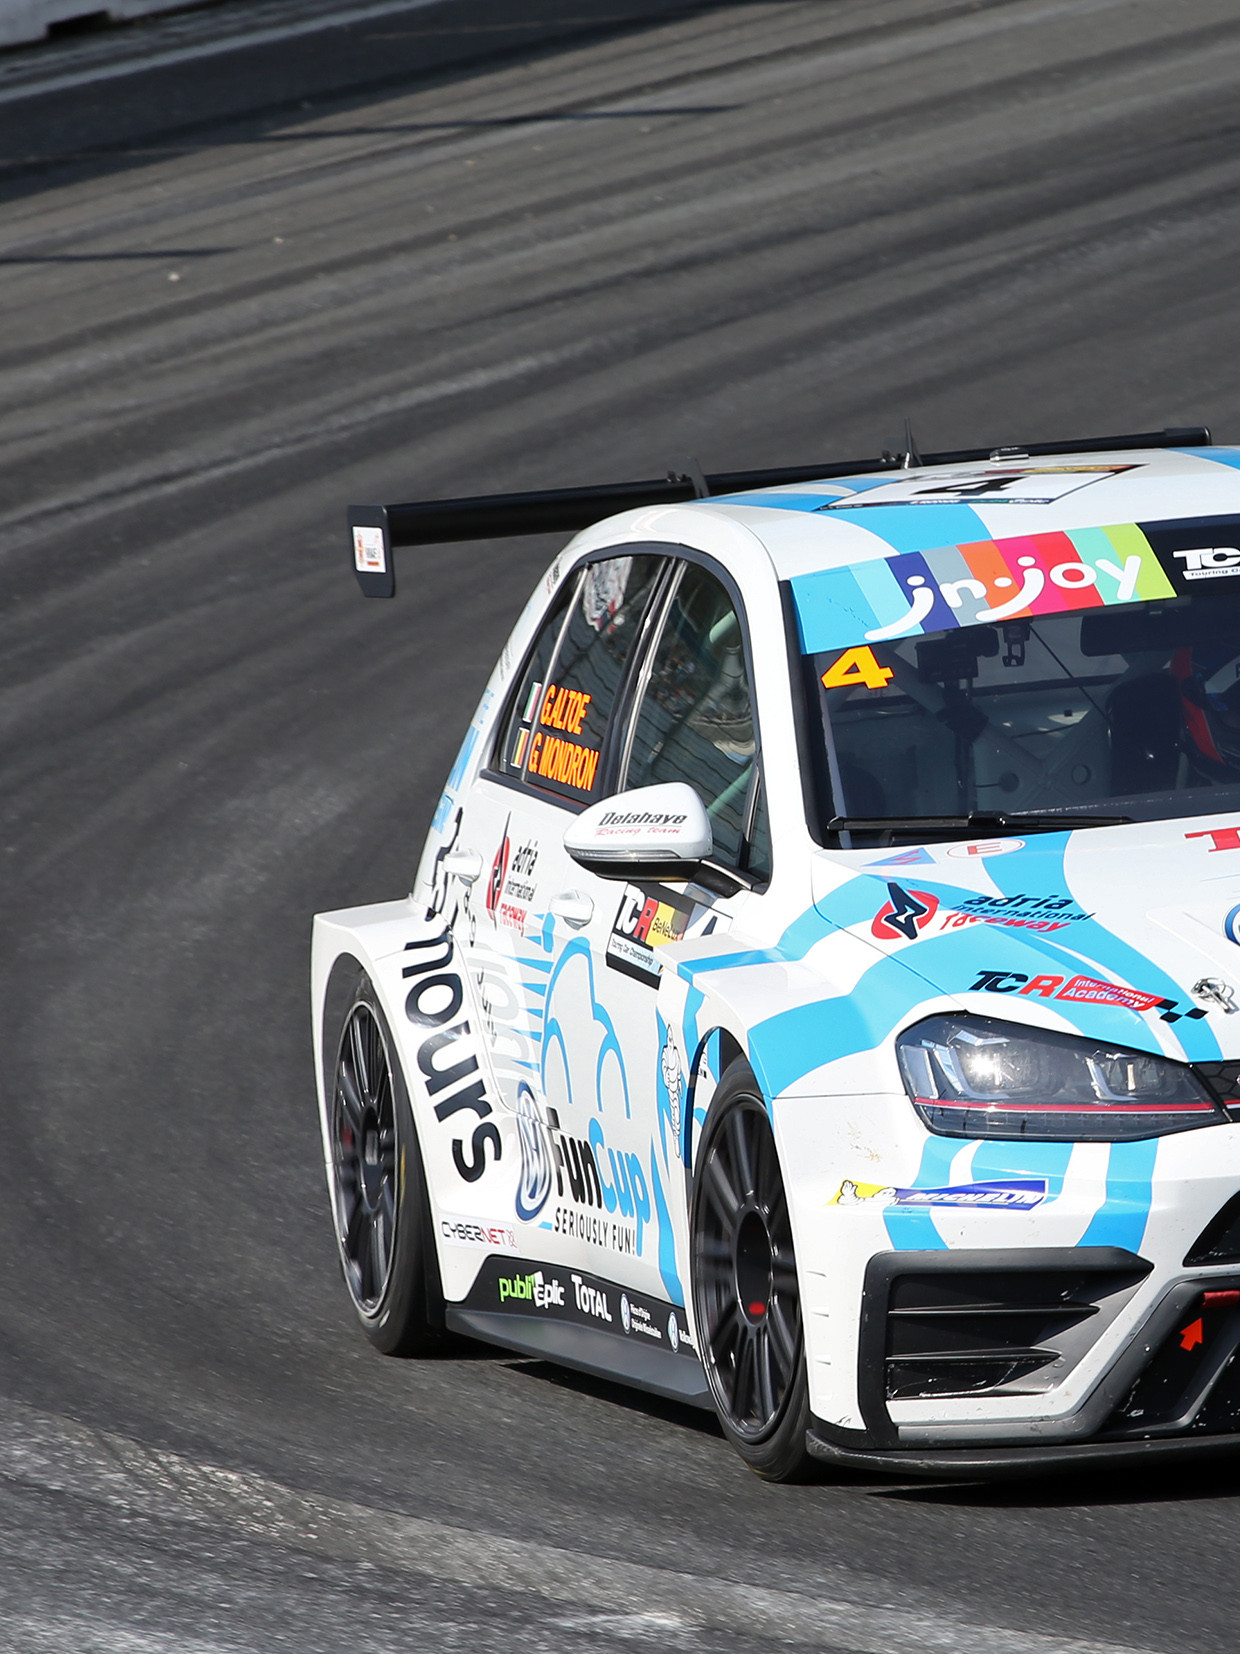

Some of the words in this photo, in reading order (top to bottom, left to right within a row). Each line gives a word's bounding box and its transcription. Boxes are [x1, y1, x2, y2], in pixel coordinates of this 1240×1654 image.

[821, 645, 895, 690] 4
[598, 812, 688, 826] Delahaye
[647, 826, 680, 834] team
[963, 893, 1074, 910] adria
[940, 912, 1072, 933] raceway
[952, 904, 1097, 923] international
[968, 970, 1065, 998] TCR
[1073, 978, 1155, 1004] International
[1062, 986, 1146, 1009] Academy
[546, 1106, 651, 1258] FunCup
[554, 1207, 609, 1247] SERIOUSLY
[612, 1224, 636, 1256] FUN!
[570, 1274, 613, 1323] TOTAL
